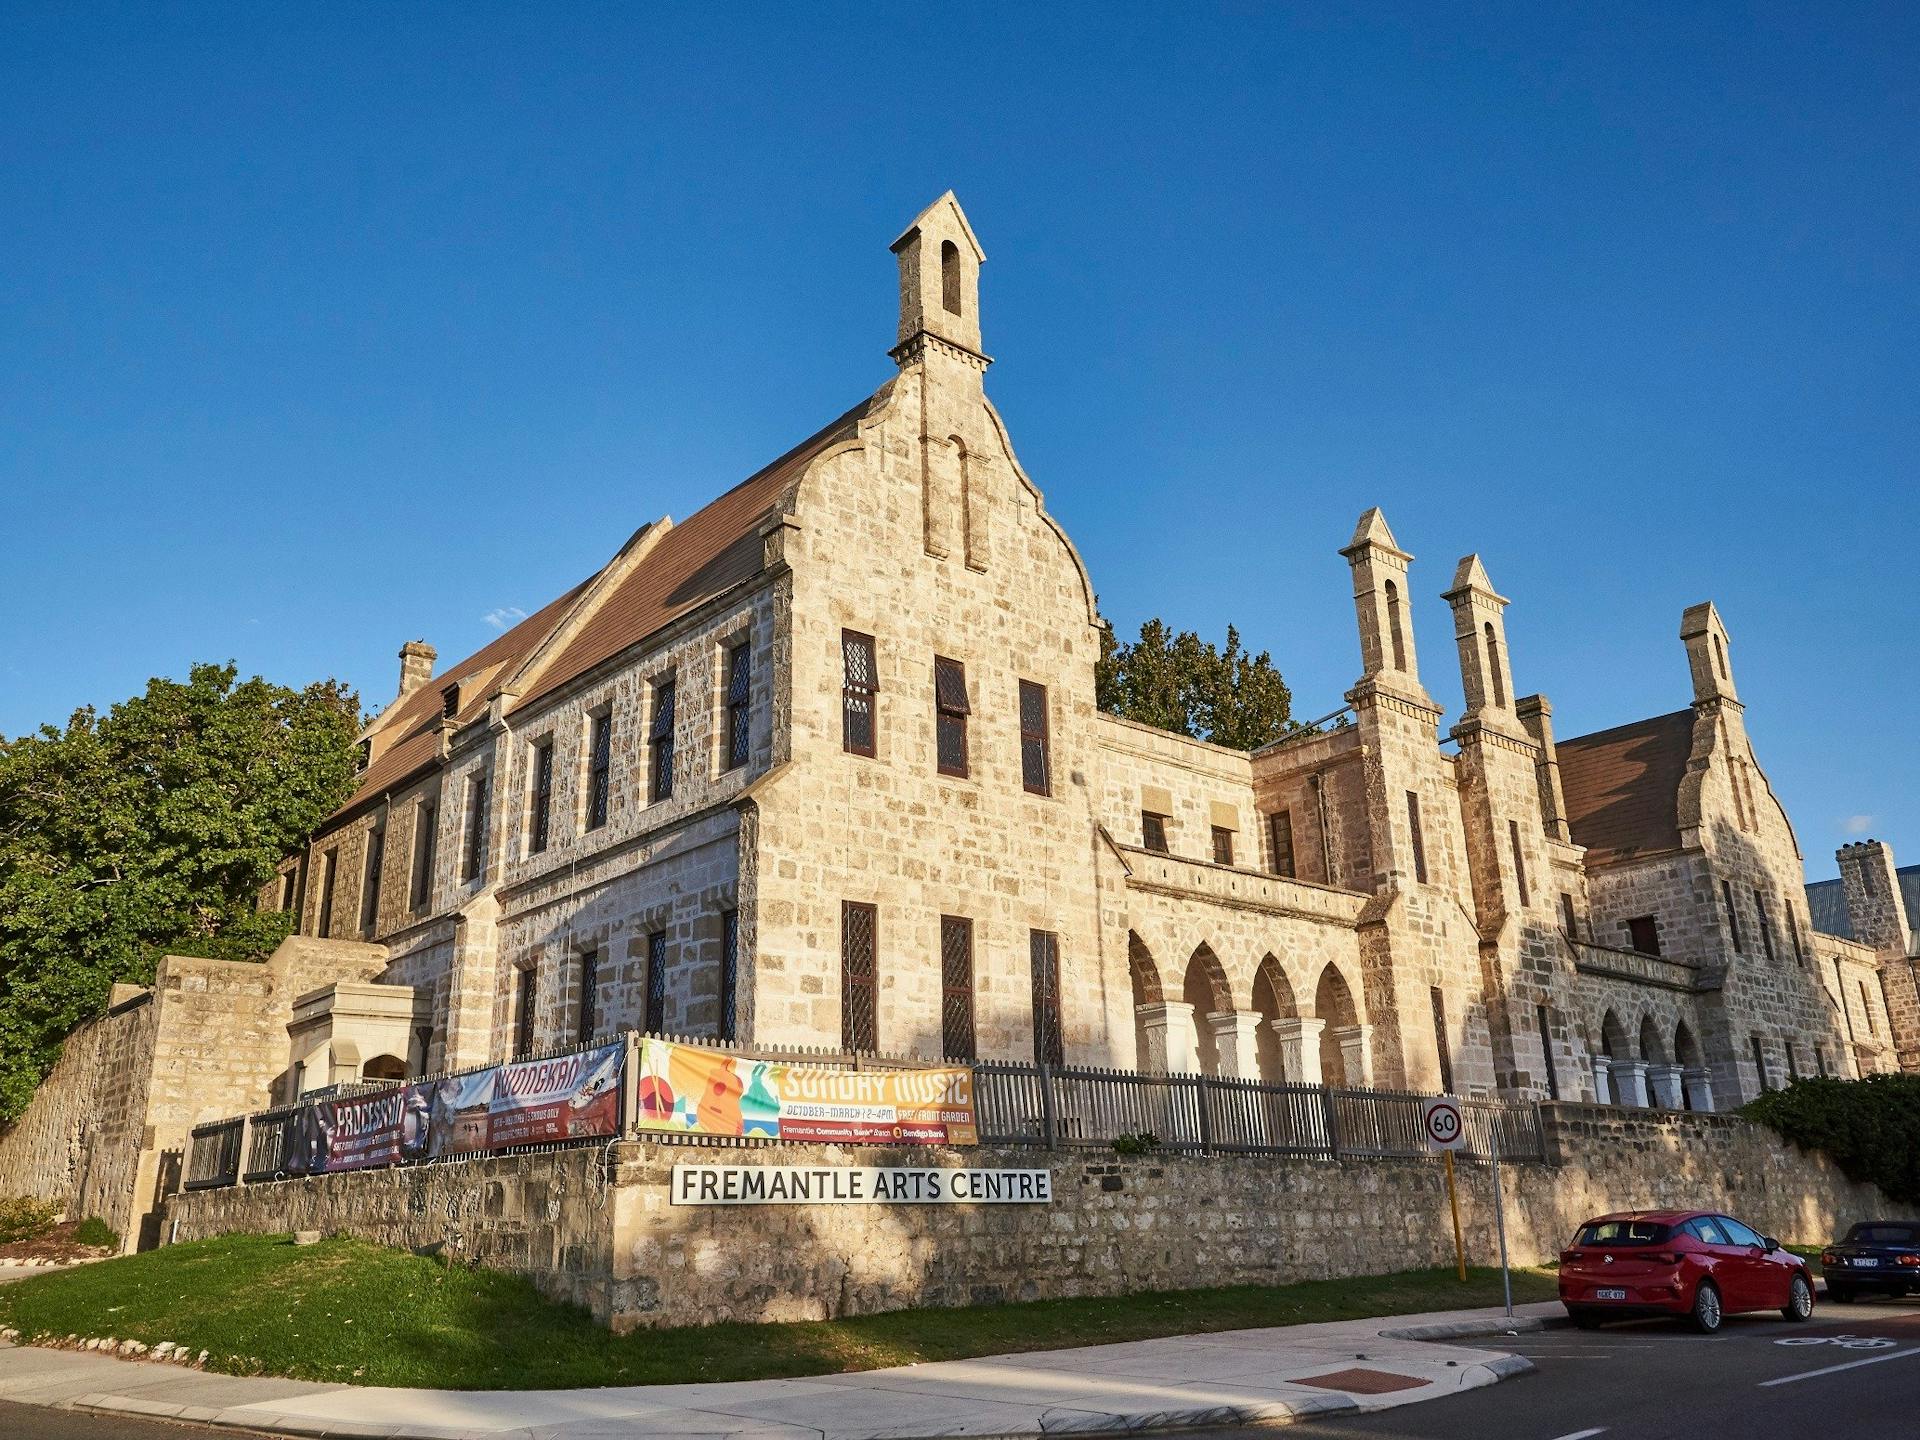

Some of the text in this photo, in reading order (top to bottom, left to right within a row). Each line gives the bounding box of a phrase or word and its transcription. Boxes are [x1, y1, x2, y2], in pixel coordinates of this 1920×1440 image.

[784, 1068, 969, 1105] SUNDAY MUSIC
[941, 1111, 970, 1123] GARDEN
[1433, 1114, 1455, 1132] 60
[782, 1125, 815, 1135] Fremantle
[816, 1127, 853, 1137] Community
[903, 1129, 928, 1139] Bendigo
[929, 1130, 945, 1138] Bank
[682, 1170, 1048, 1200] FREMANTLE ARTS CENTRE
